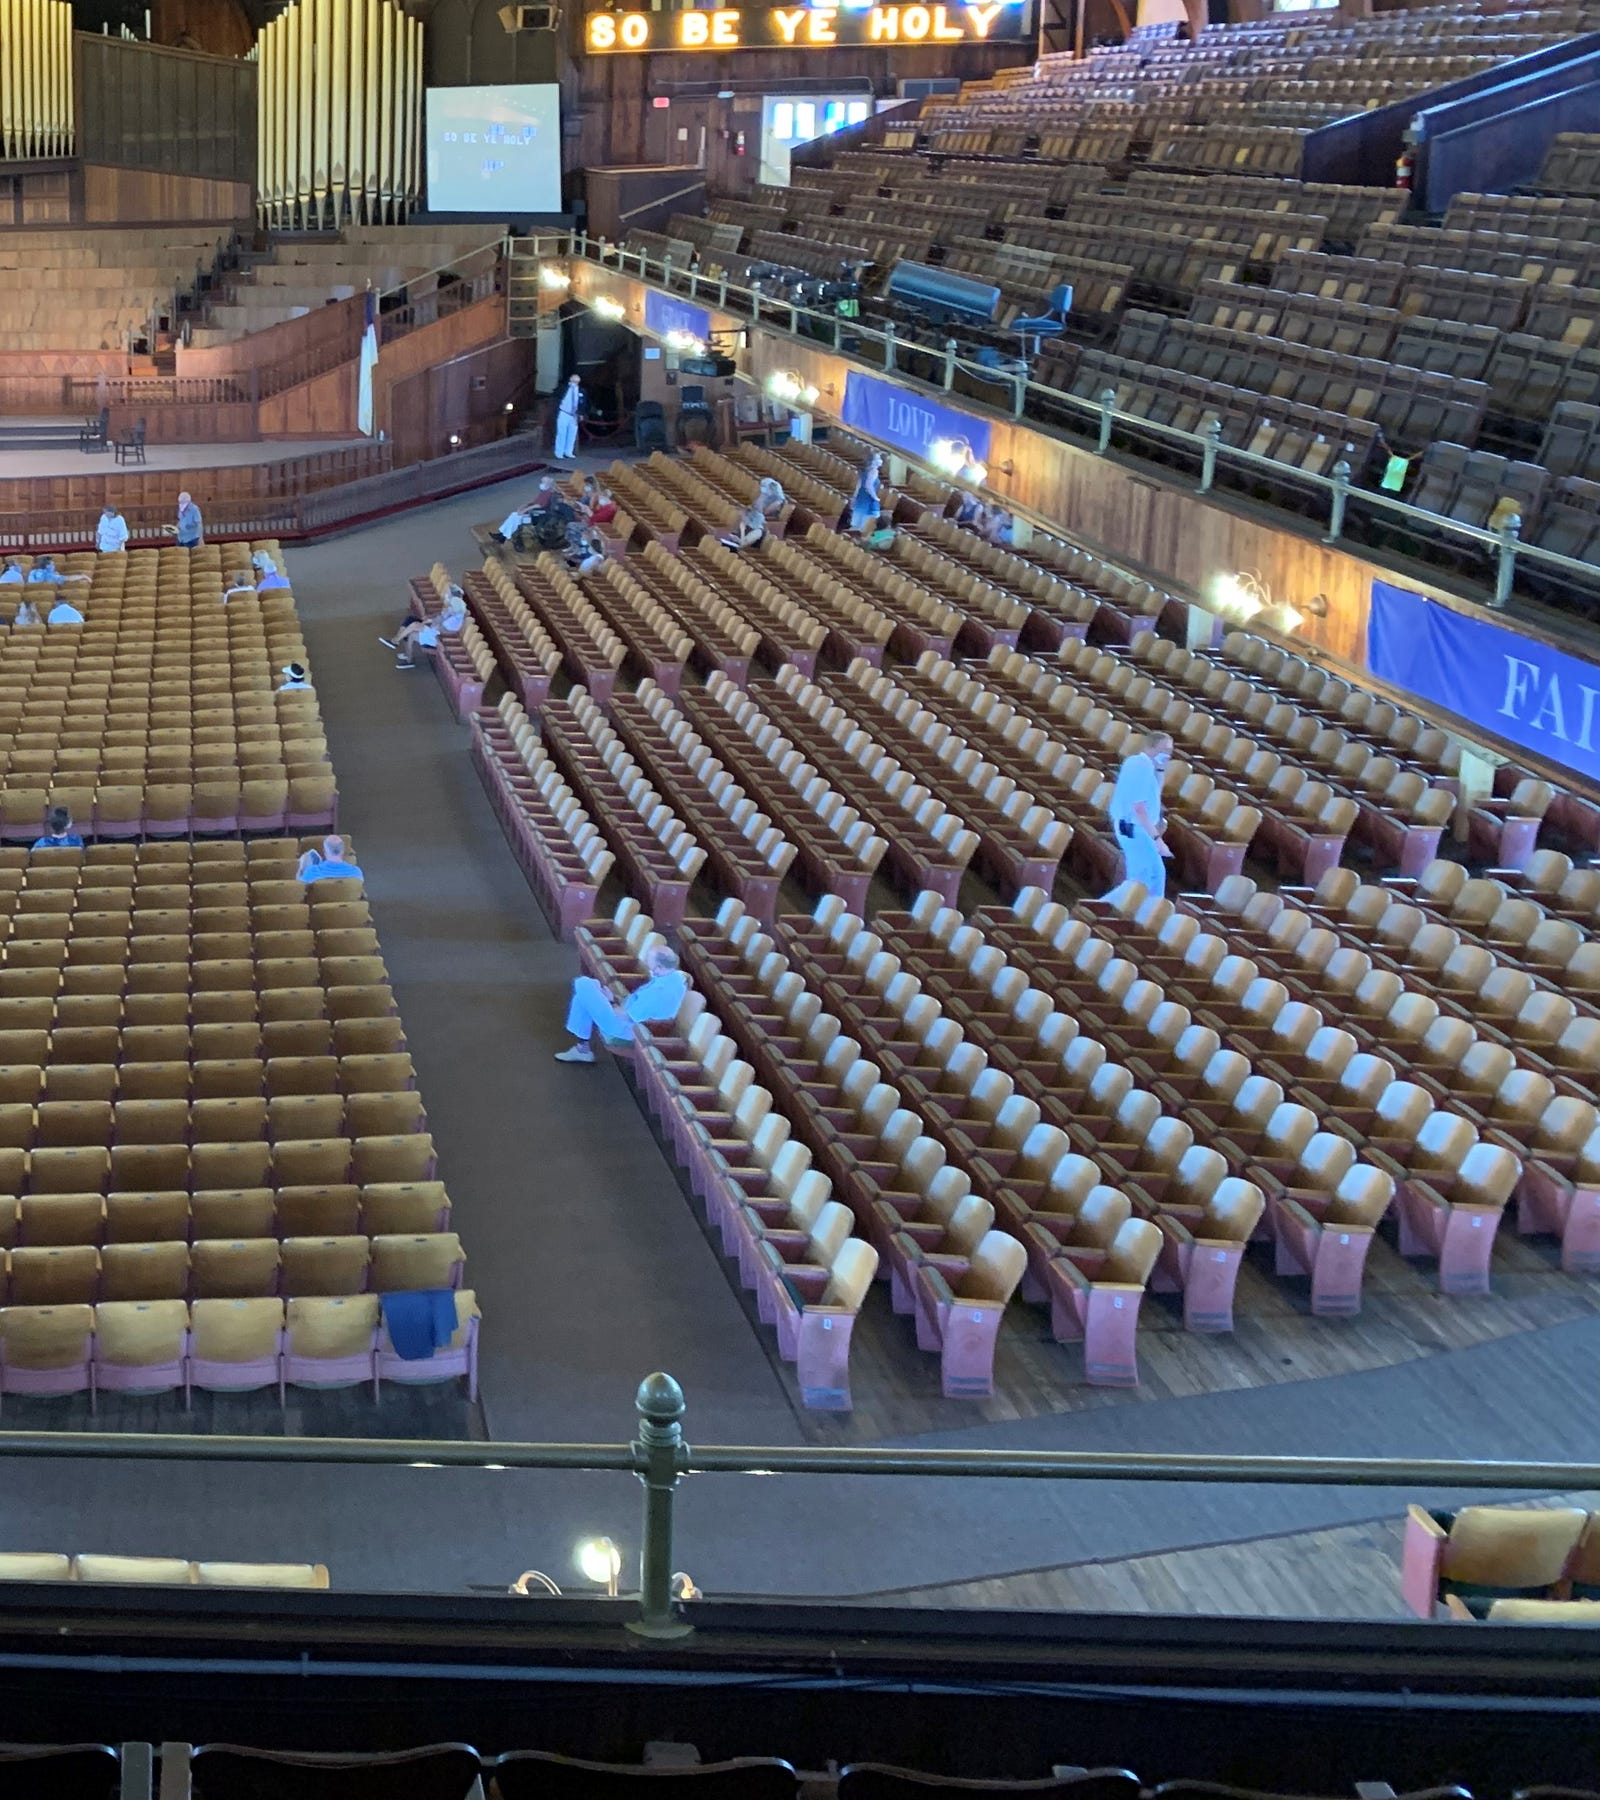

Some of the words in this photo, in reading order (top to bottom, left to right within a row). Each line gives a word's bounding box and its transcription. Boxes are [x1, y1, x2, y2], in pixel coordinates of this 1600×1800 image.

[590, 13, 648, 47] SO
[681, 11, 740, 45] BE
[775, 8, 837, 43] YE
[871, 4, 1000, 40] HOLY
[888, 397, 936, 448] LOVE
